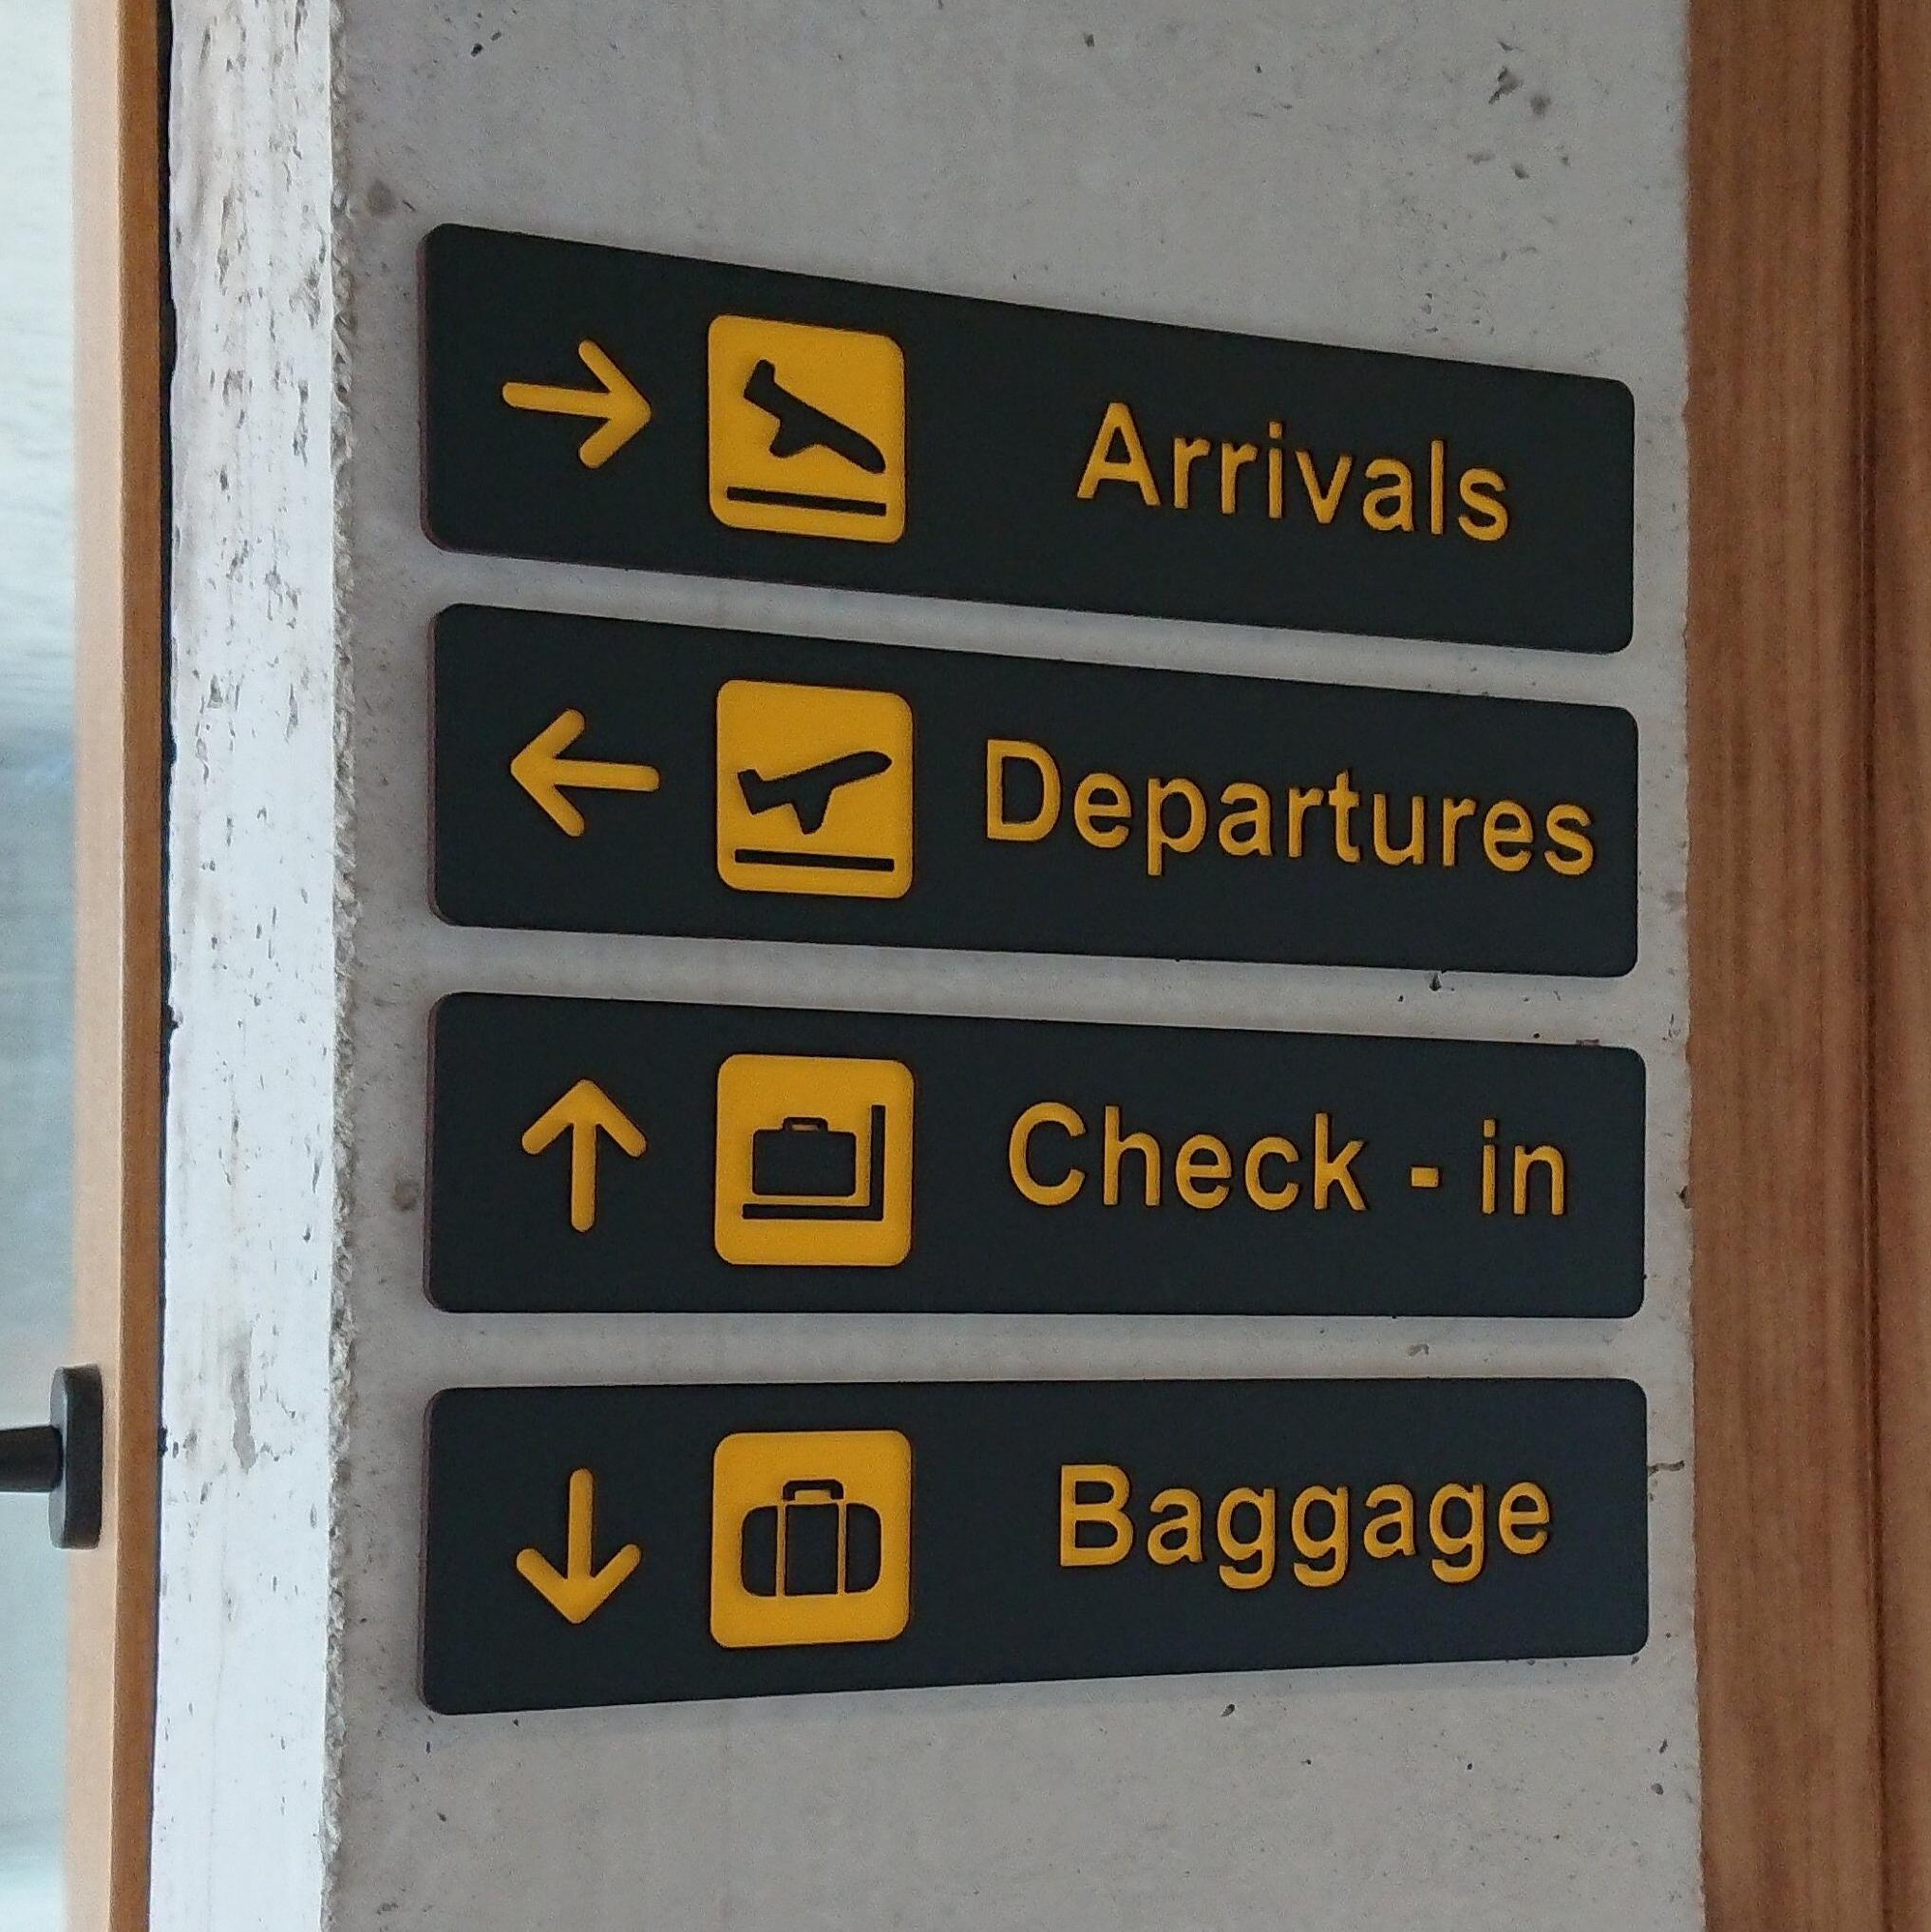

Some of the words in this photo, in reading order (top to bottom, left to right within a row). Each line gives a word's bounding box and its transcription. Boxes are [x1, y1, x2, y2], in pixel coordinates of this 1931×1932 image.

[1077, 402, 1509, 542] Arrivals
[985, 739, 1595, 877] Departures
[1060, 1464, 1551, 1590] Baggage
